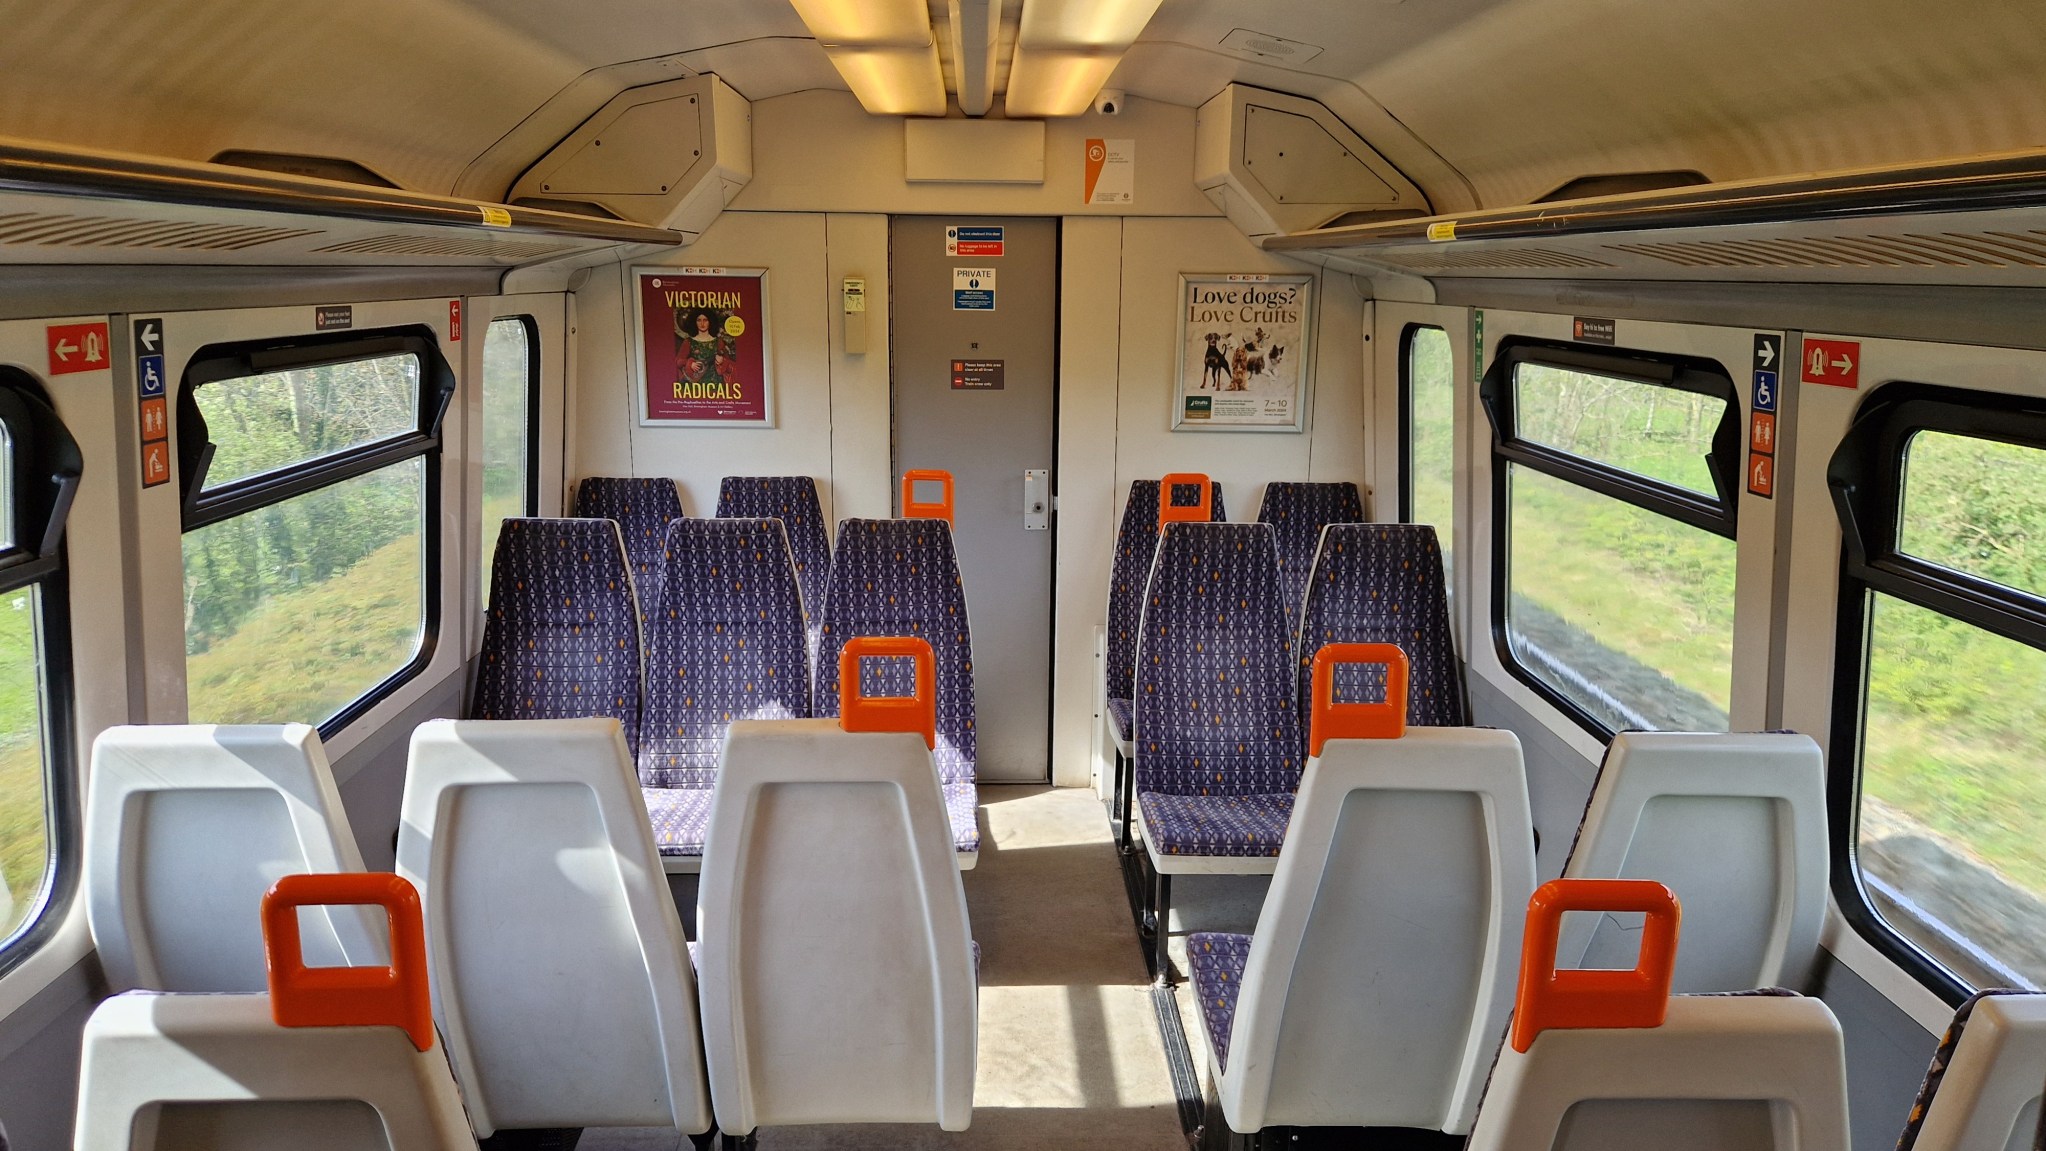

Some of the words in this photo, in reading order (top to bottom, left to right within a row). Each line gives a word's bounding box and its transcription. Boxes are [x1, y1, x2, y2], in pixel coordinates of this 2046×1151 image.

[664, 290, 741, 309] VICTORIAN
[1193, 287, 1237, 304] Love
[1243, 287, 1296, 308] dogs?
[1190, 306, 1234, 322] Love
[1240, 306, 1297, 323] Crufts
[673, 382, 742, 400] RADICALS
